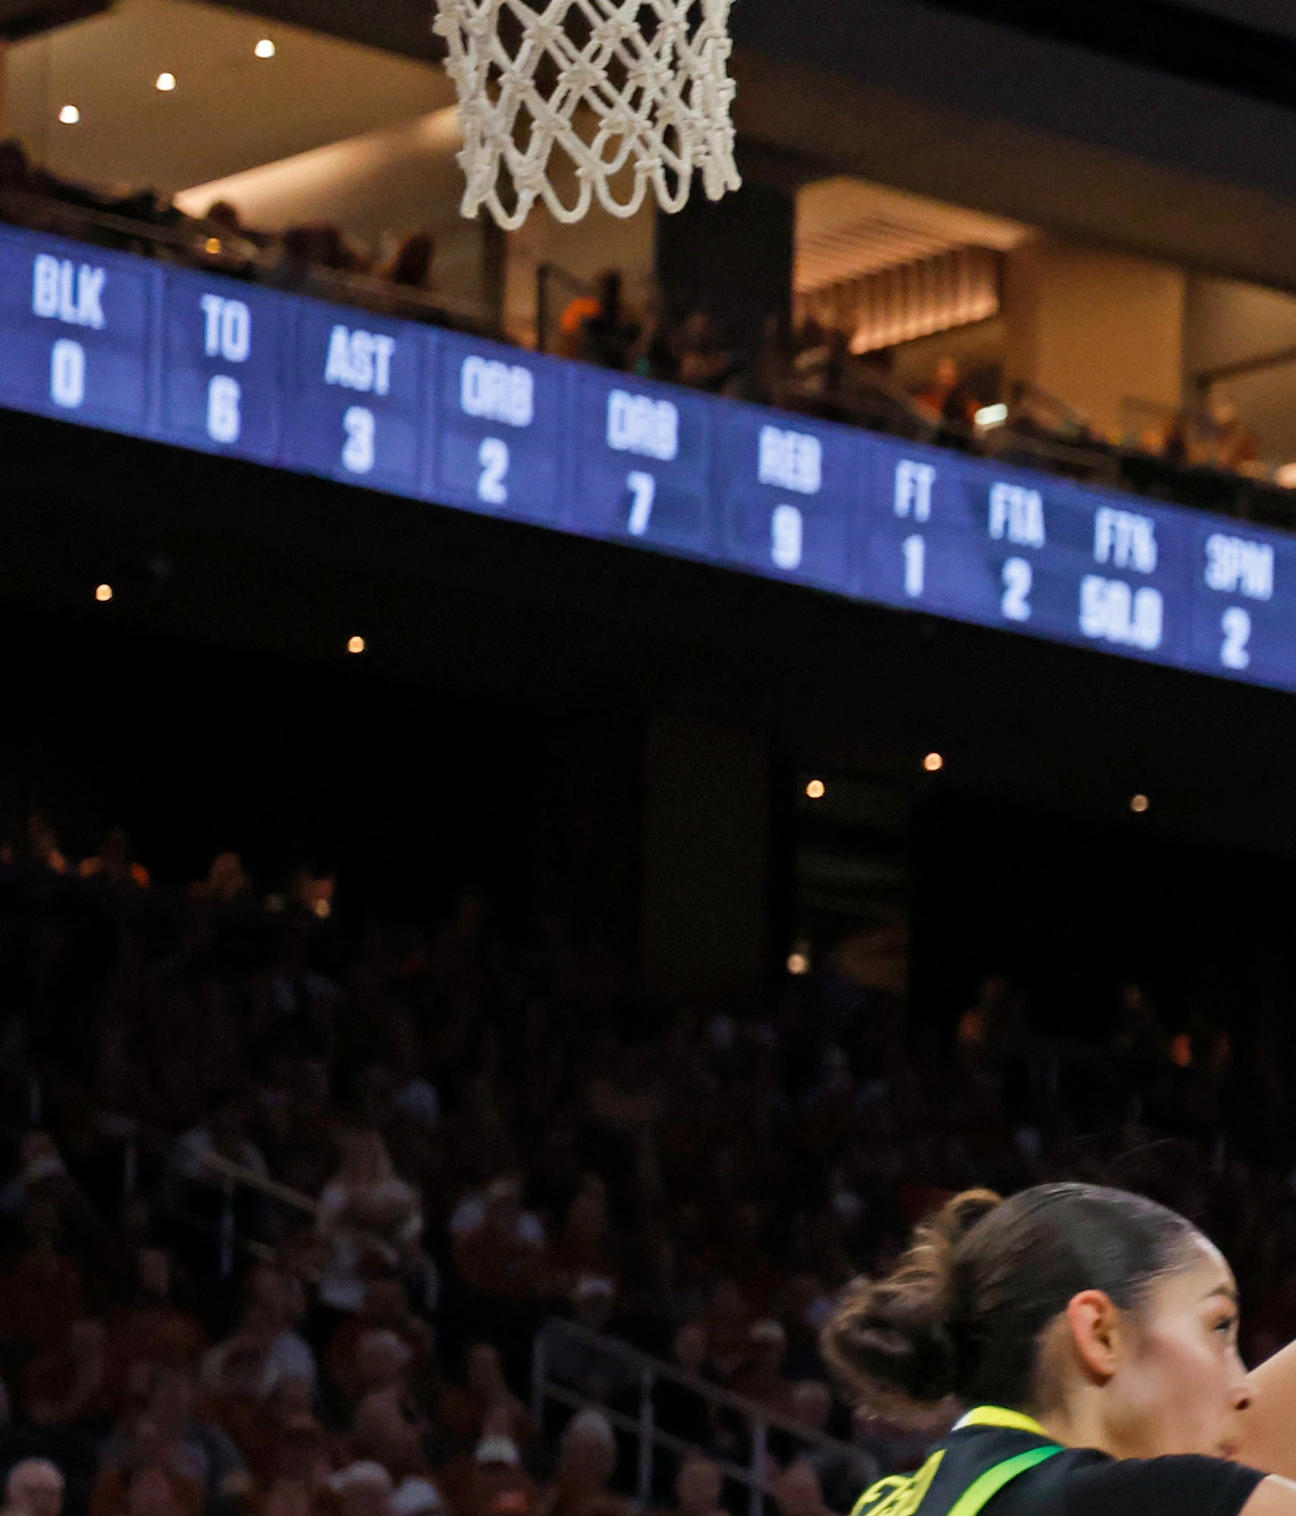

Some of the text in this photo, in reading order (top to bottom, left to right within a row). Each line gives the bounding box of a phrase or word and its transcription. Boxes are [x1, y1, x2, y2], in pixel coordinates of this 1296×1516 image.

[33, 254, 105, 328] BLK
[202, 294, 250, 362] TO
[325, 325, 394, 394] AST
[460, 355, 534, 426] ORB
[607, 389, 679, 461] DRB
[758, 425, 822, 494] REB
[894, 459, 935, 522] FT
[1205, 533, 1274, 600] 3PM
[51, 340, 85, 408] 0
[207, 375, 240, 443] 6
[342, 406, 375, 475] 3
[477, 438, 509, 504] 2
[627, 471, 655, 535] 7
[903, 535, 925, 597] 1
[1002, 556, 1032, 621] 2
[1221, 606, 1251, 670] 2
